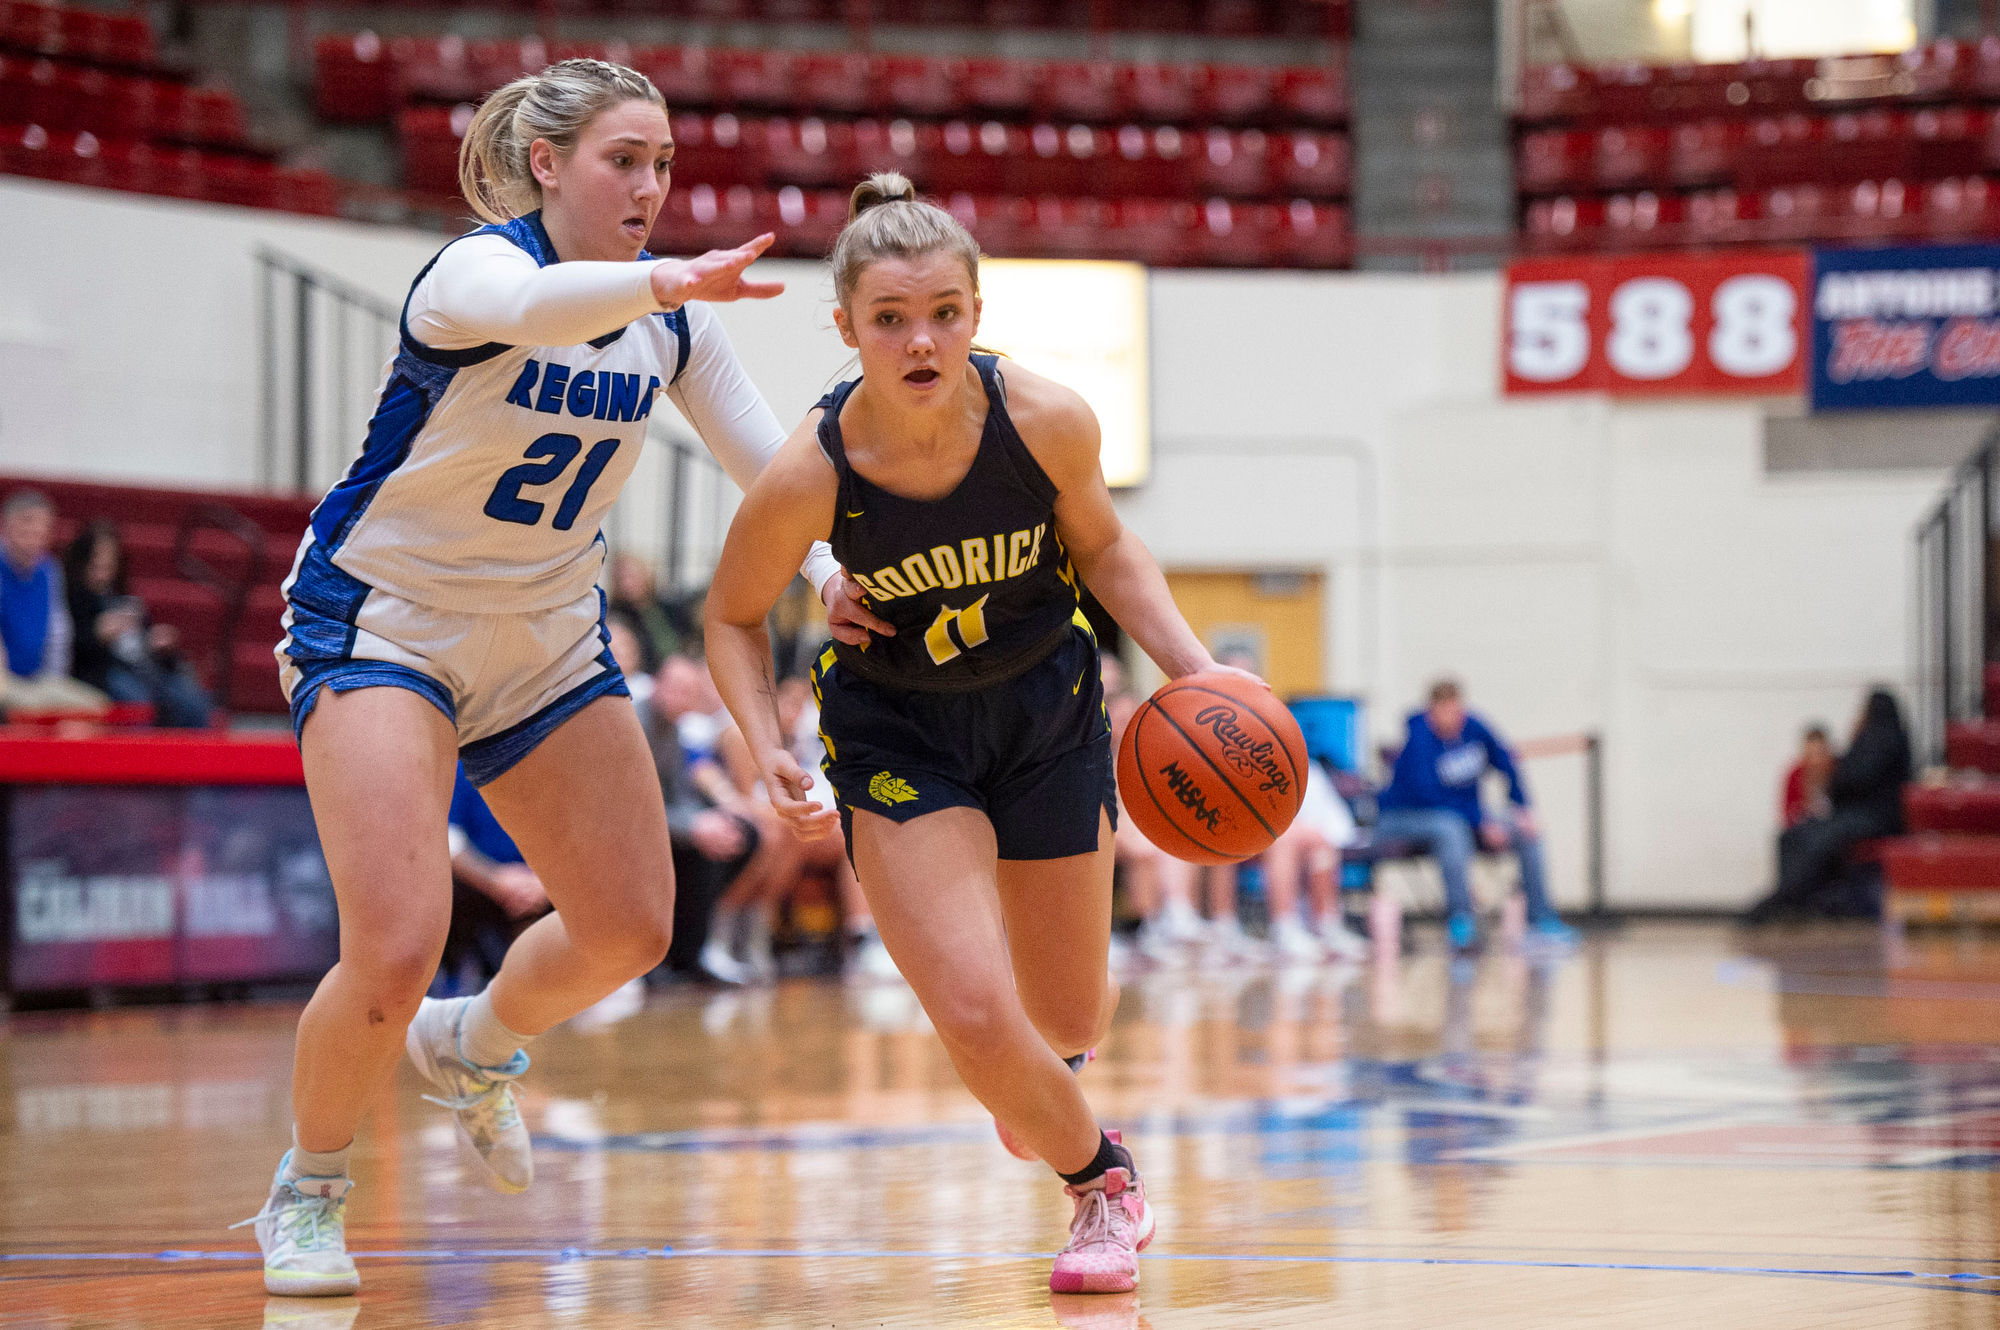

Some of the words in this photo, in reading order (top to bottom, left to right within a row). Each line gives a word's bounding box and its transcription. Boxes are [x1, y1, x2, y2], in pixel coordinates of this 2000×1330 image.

[1509, 273, 1798, 383] 588
[505, 358, 660, 423] REGINA
[484, 433, 621, 531] 21
[852, 521, 1046, 602] GOODRICH
[1196, 706, 1292, 796] Rawlings
